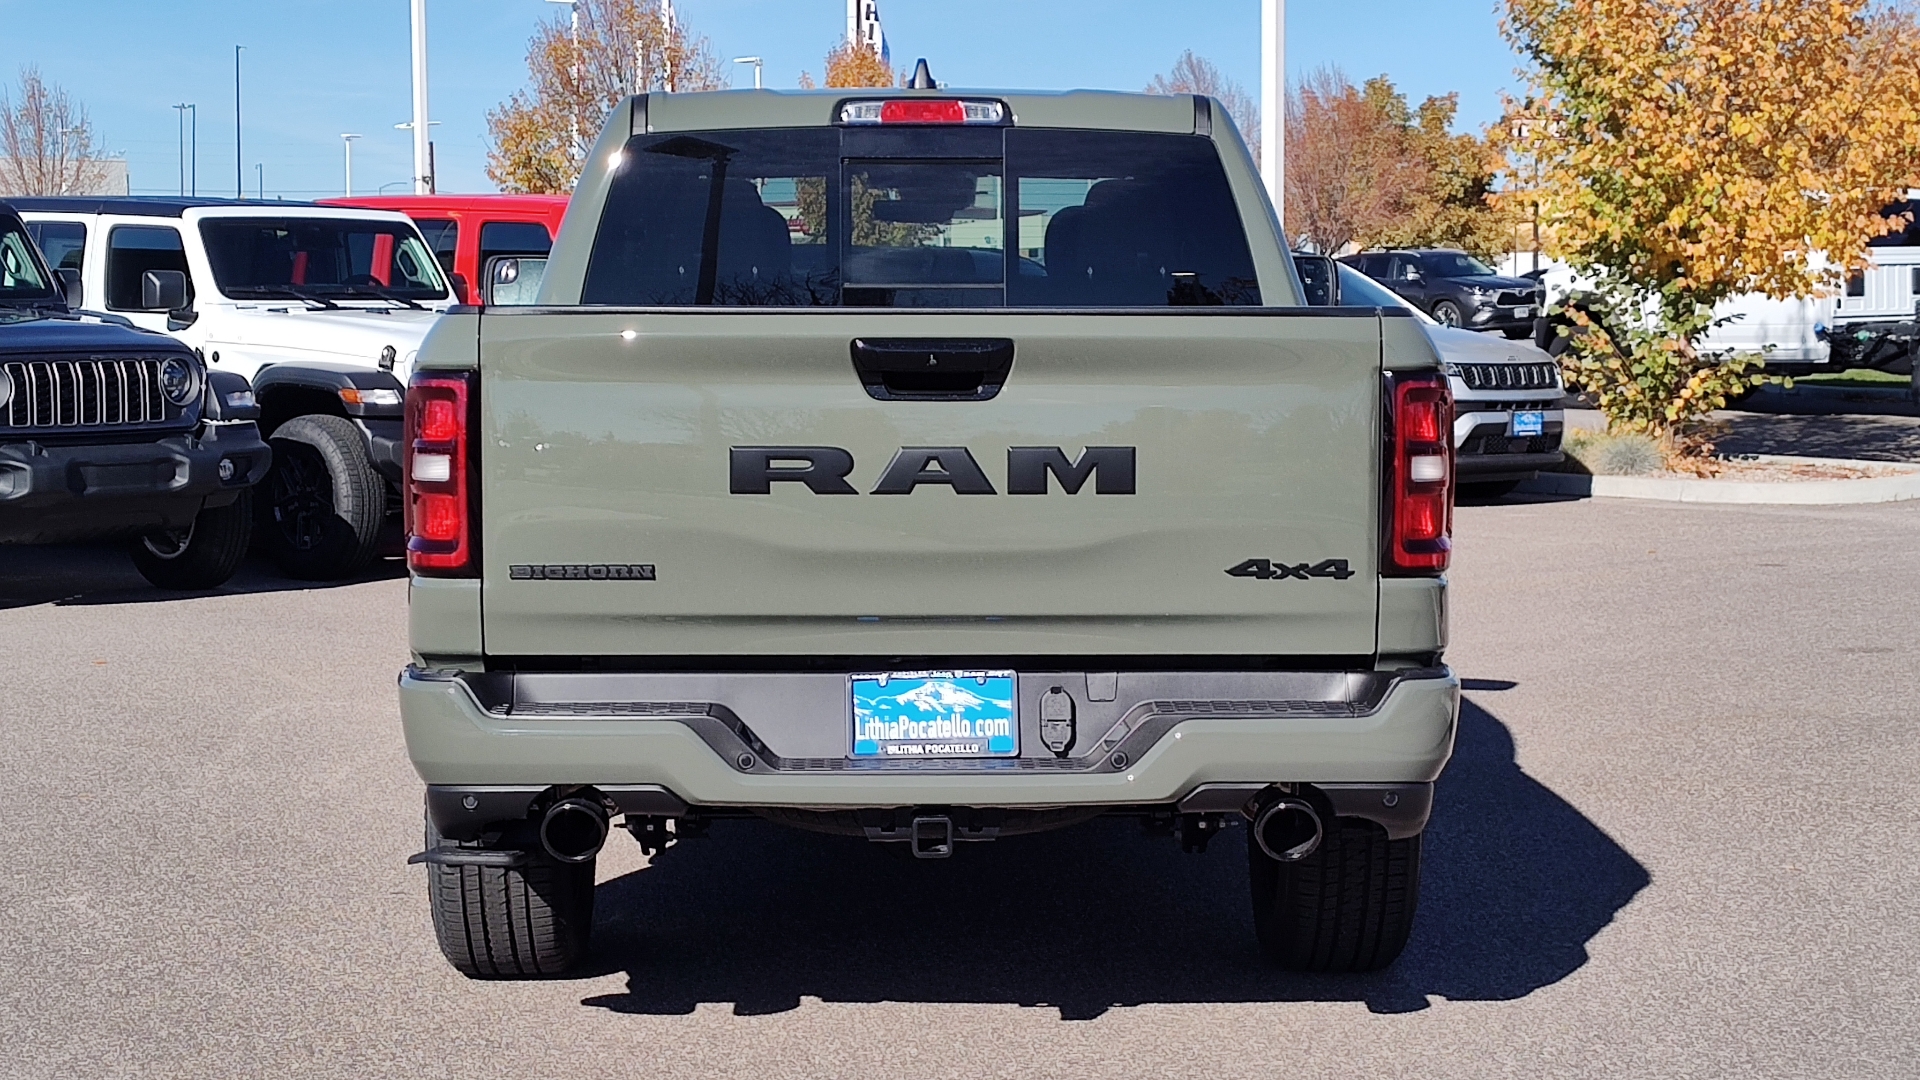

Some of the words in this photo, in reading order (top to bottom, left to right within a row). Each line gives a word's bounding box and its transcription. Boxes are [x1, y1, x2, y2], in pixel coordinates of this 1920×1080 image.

[729, 445, 1137, 496] RAM
[509, 564, 657, 581] BIGHORN
[1223, 558, 1356, 580] 4x4
[855, 713, 1010, 740] LithiaPocatello.com
[925, 743, 979, 754] POCATELLO
